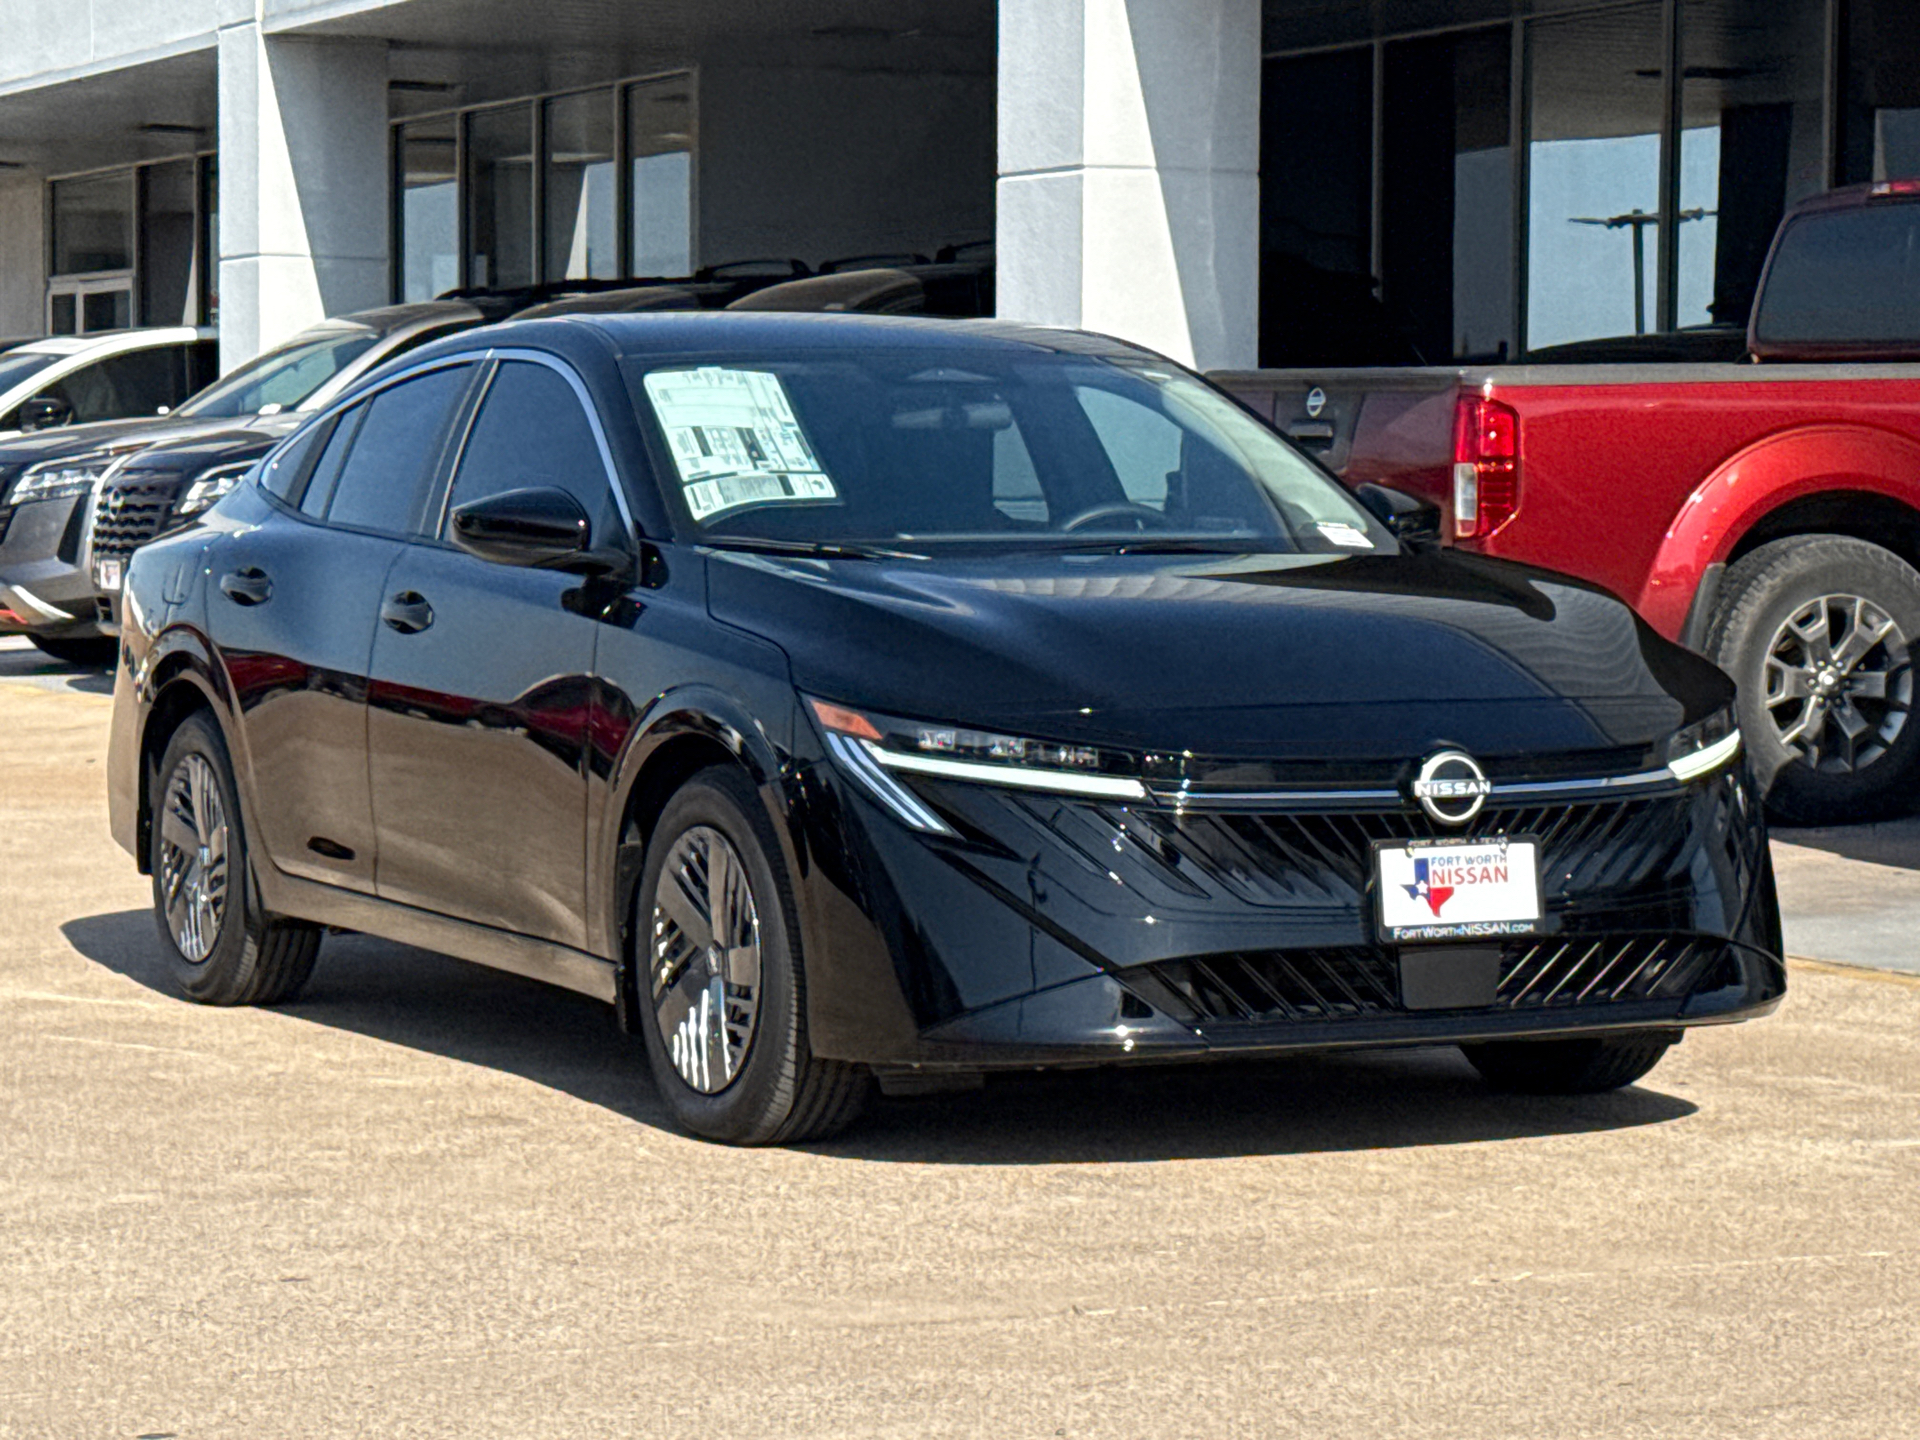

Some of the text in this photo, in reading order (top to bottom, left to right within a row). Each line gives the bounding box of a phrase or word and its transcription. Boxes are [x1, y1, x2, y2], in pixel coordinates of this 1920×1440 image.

[1414, 780, 1491, 797] NISSAN
[1431, 854, 1507, 867] FORT WORTH
[1432, 865, 1508, 885] NISSAN
